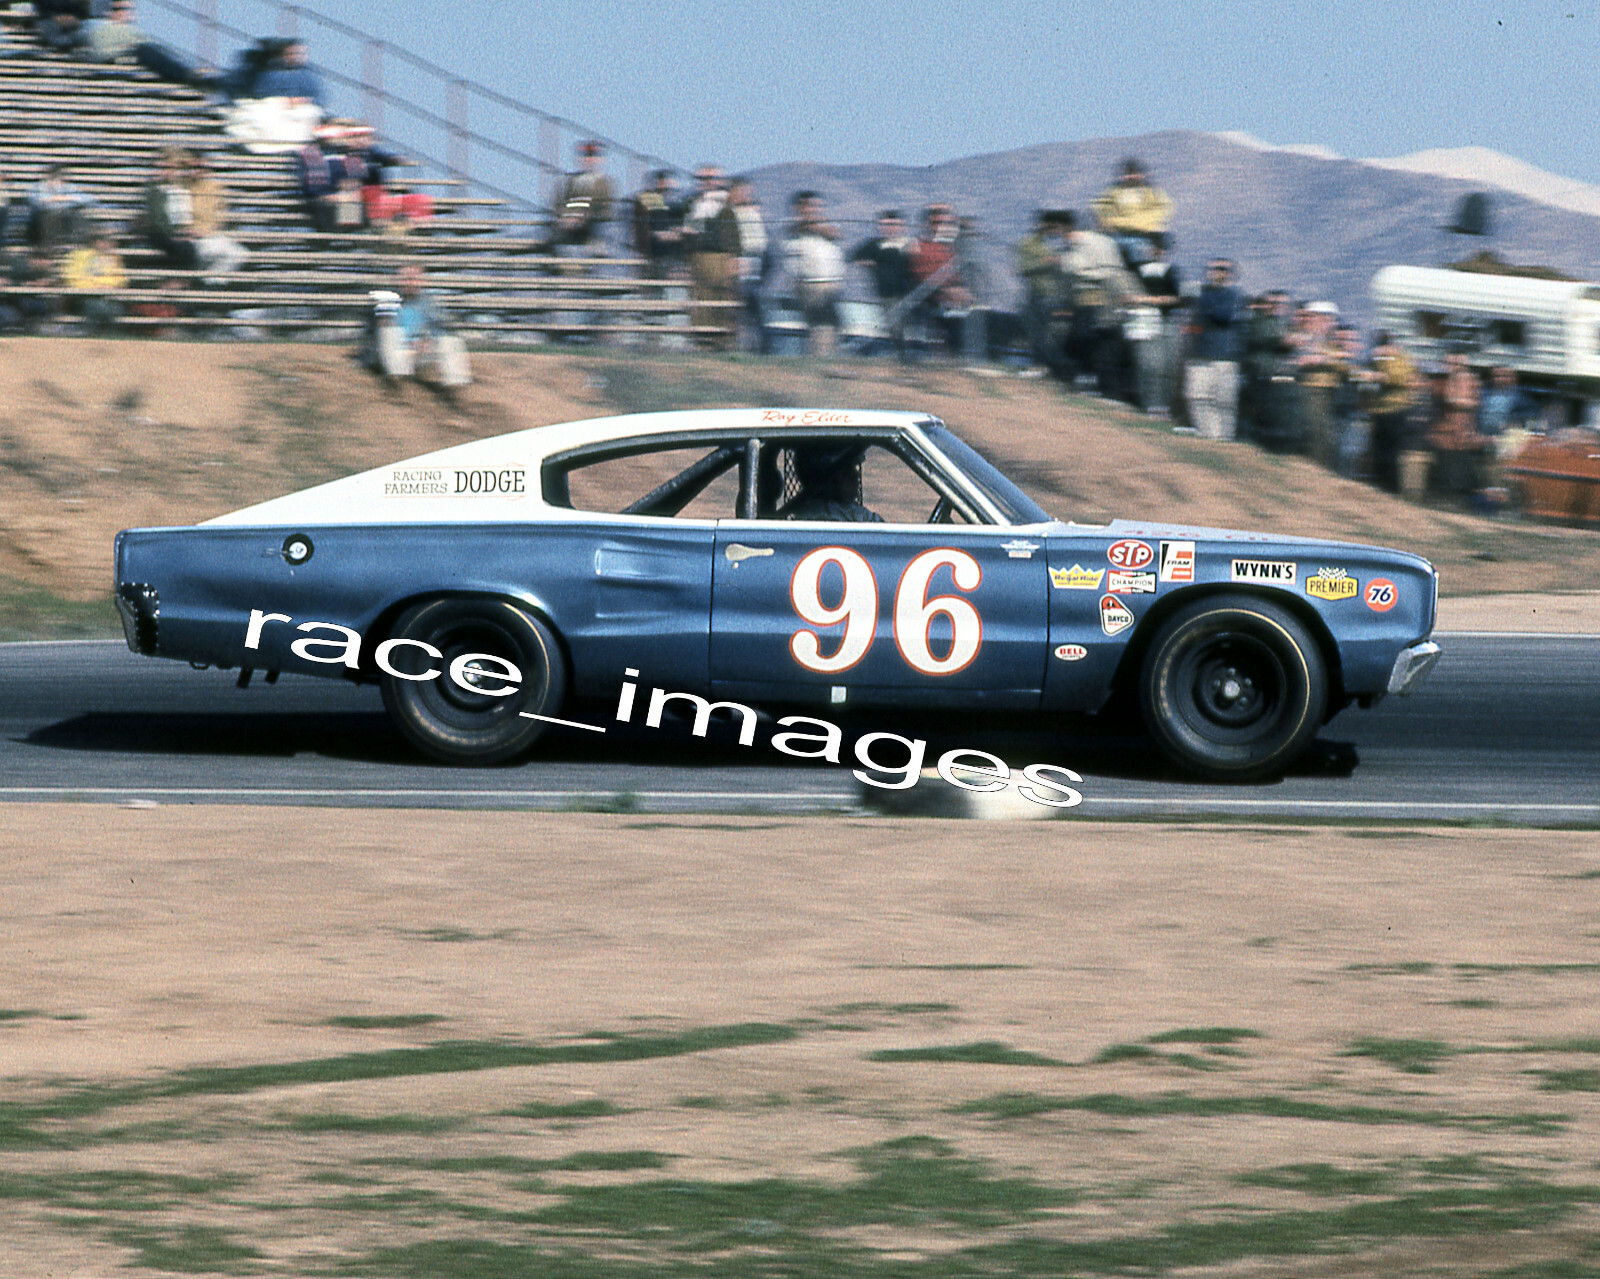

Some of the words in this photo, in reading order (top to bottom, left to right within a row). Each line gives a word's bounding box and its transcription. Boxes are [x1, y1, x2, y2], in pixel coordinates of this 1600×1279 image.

[762, 410, 795, 426] Ray
[393, 470, 442, 481] RACING
[453, 470, 525, 494] DODGE
[384, 483, 448, 495] FARMERS
[1111, 542, 1150, 567] STP
[1235, 562, 1293, 579] WYNN'S
[1111, 578, 1153, 586] CHAMPION
[1309, 580, 1354, 594] PREMIER
[1368, 584, 1394, 605] 76
[789, 545, 983, 677] 96
[1107, 615, 1129, 623] DAYCO
[1059, 647, 1084, 655] BELL
